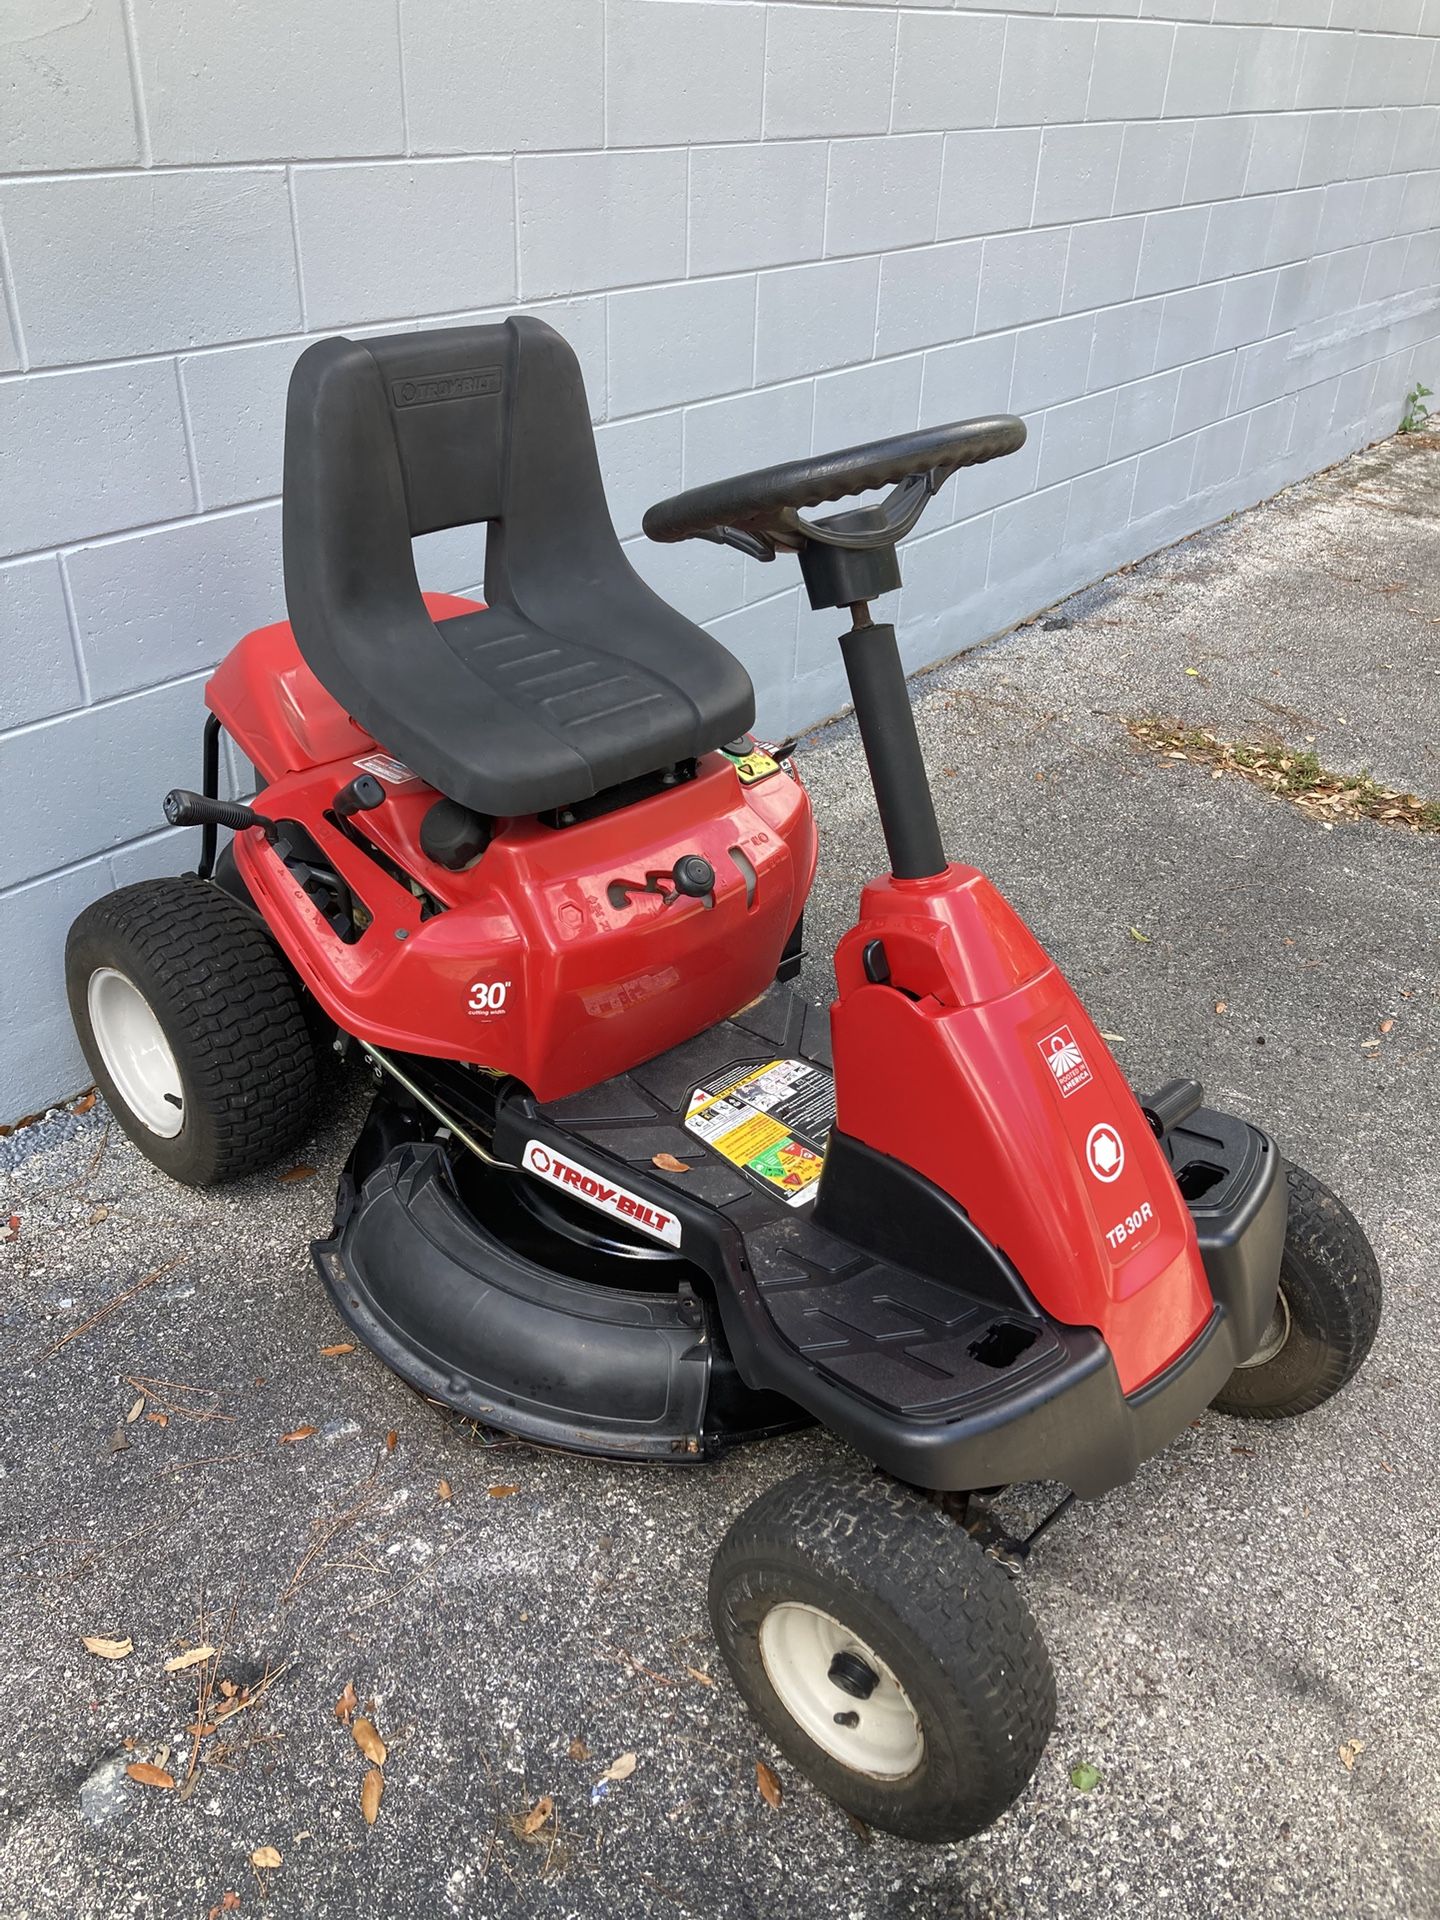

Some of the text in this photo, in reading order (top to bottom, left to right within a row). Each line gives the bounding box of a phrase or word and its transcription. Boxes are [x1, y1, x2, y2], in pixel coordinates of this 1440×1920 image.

[1059, 1067, 1080, 1085] ROOTED
[1062, 1070, 1090, 1093] AMERICA
[552, 1160, 671, 1232] TROY-BILT
